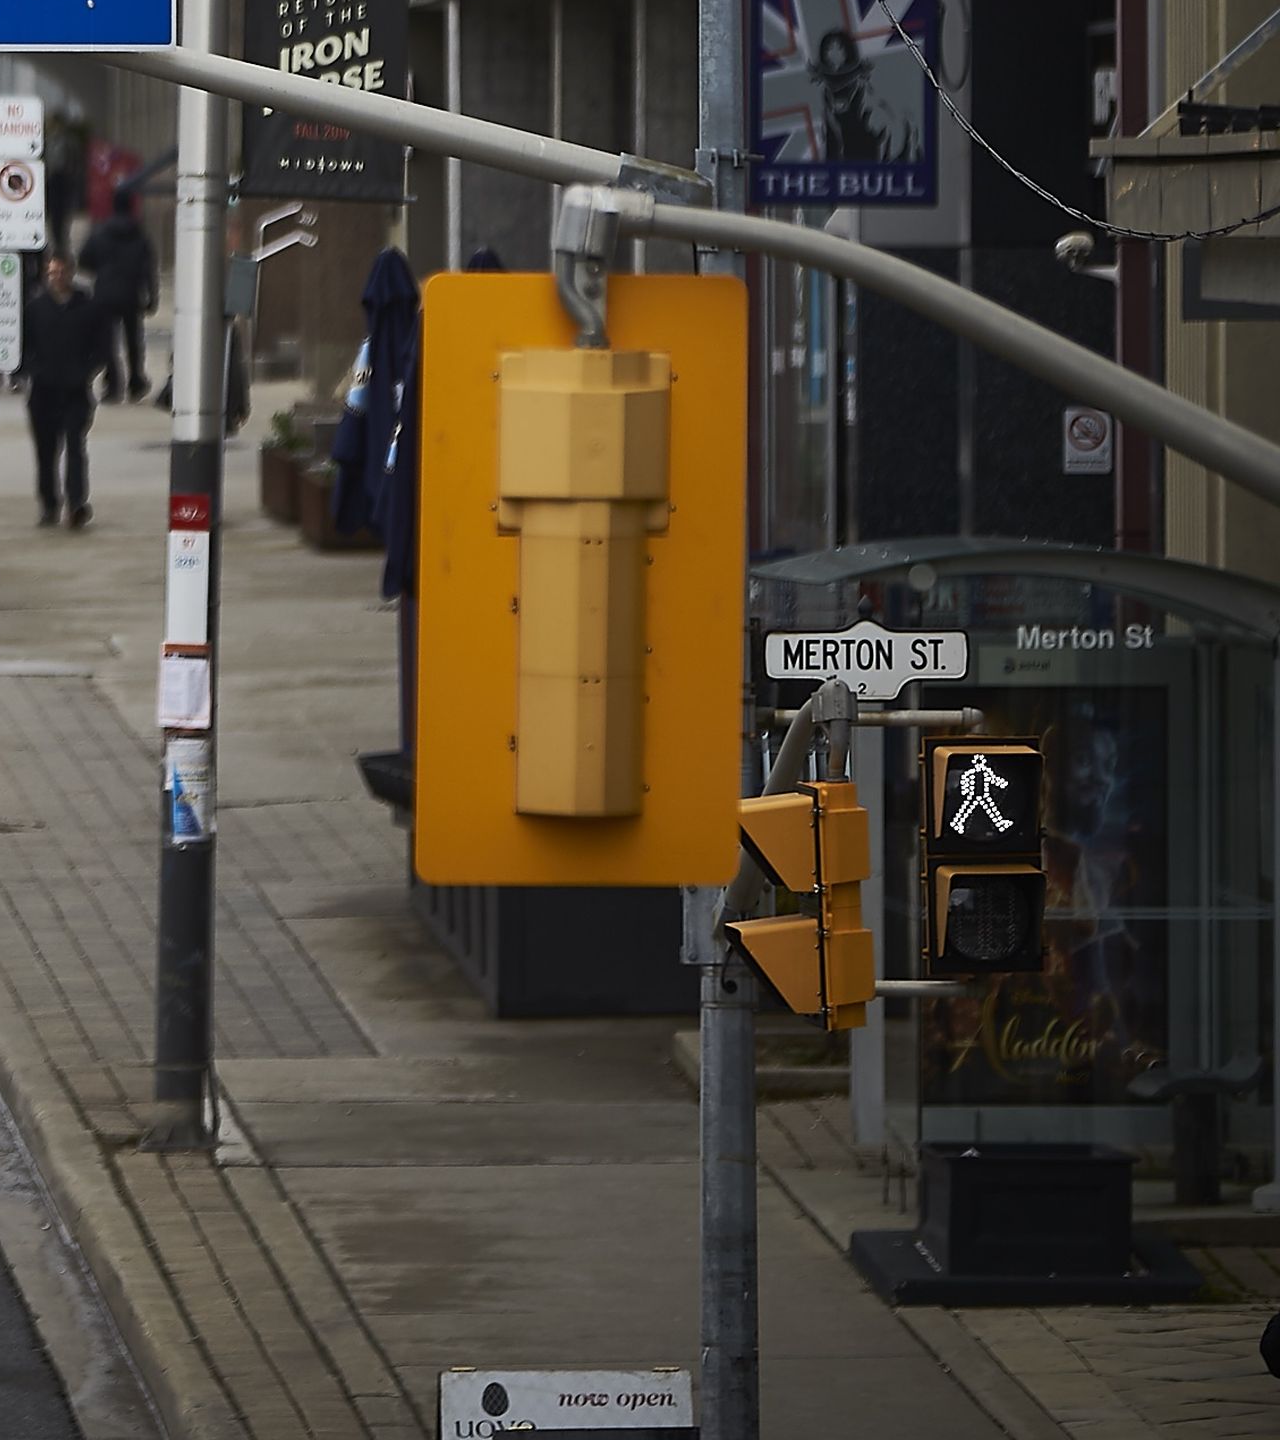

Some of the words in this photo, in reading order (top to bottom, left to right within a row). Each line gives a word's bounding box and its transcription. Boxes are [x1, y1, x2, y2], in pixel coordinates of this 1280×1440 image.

[280, 17, 309, 39] OF
[325, 4, 368, 27] THE
[279, 27, 371, 75] IRON
[7, 103, 24, 118] NO
[758, 170, 831, 198] THE
[839, 170, 927, 198] BULL
[1016, 624, 1115, 651] Merton
[1124, 623, 1154, 650] St
[783, 639, 893, 671] MERTON
[910, 639, 947, 671] ST.
[857, 682, 867, 695] 2
[947, 990, 1104, 1083] Aladdin
[558, 1392, 610, 1408] now
